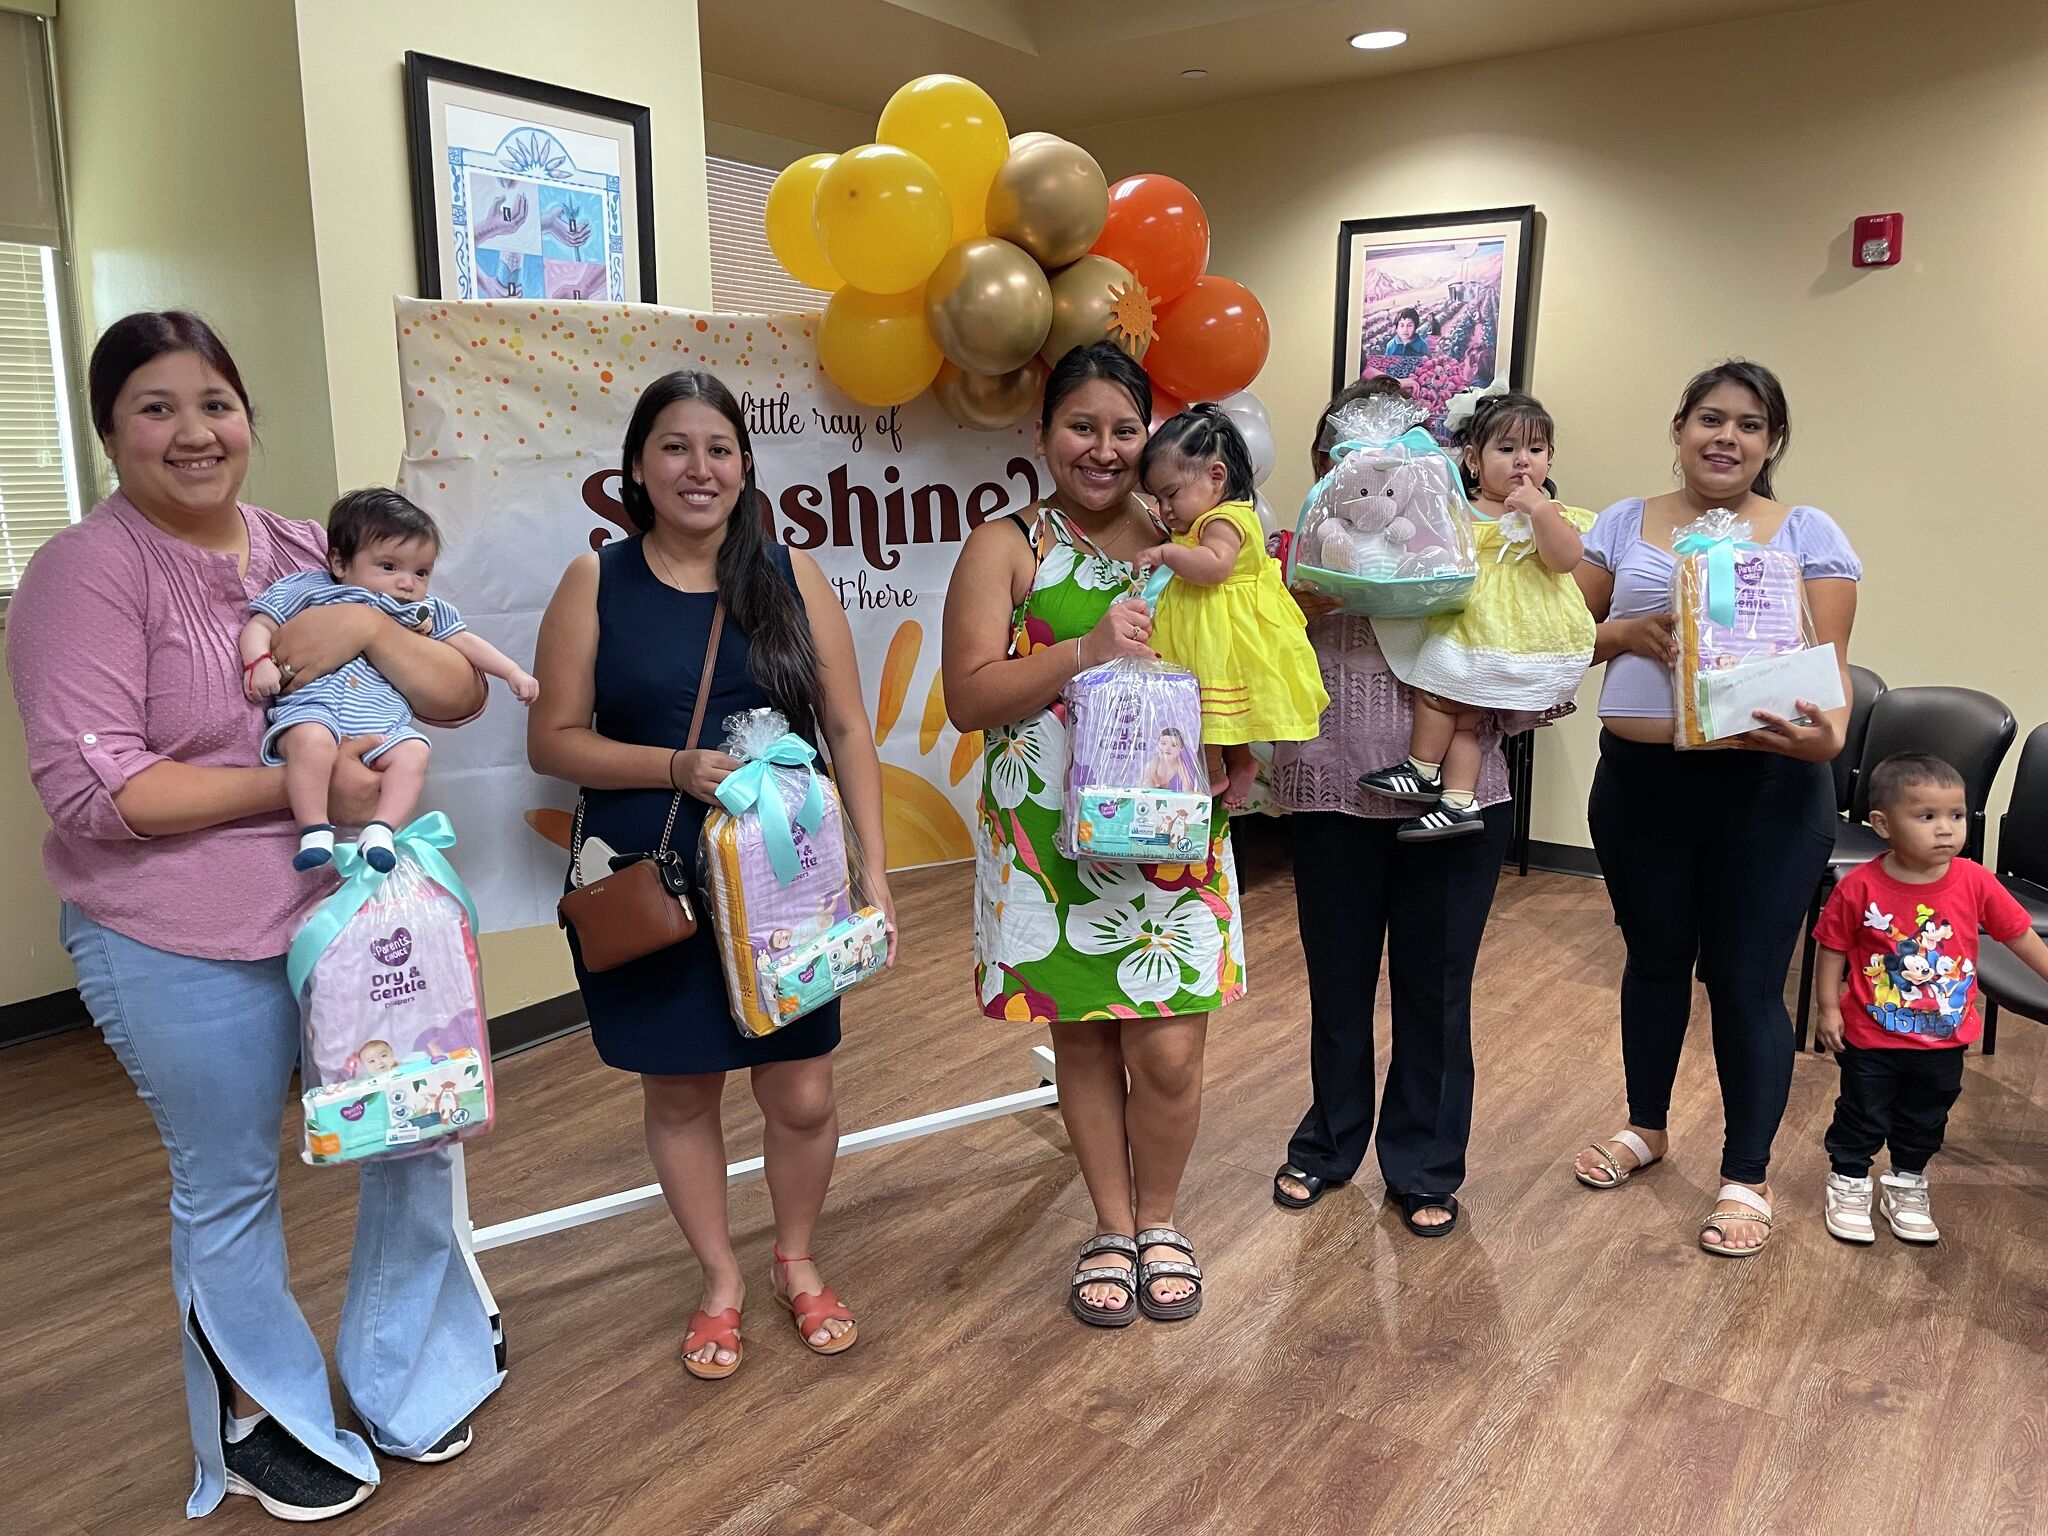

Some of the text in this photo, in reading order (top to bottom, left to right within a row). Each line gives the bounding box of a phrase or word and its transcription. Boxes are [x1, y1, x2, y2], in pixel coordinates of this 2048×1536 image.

[741, 391, 903, 453] little ray of
[581, 456, 1039, 571] Sshine
[858, 569, 918, 610] here
[369, 979, 427, 1002] Gentle
[372, 966, 420, 988] Dry &
